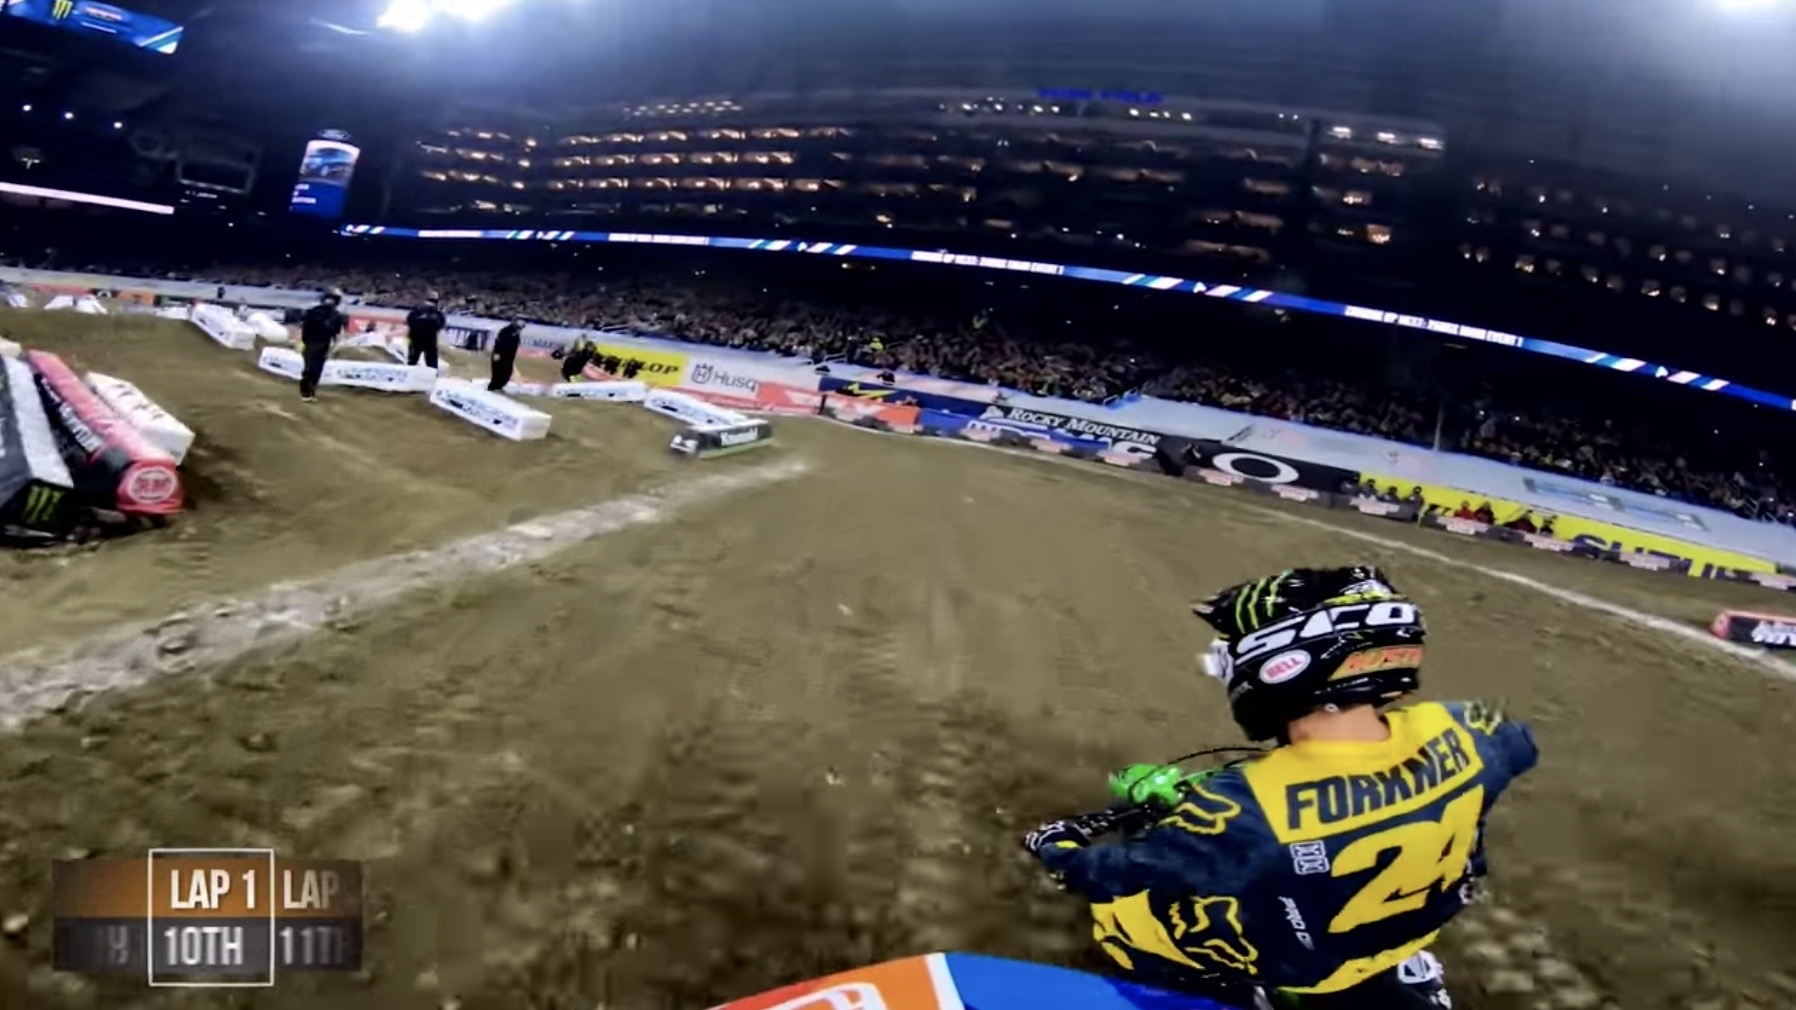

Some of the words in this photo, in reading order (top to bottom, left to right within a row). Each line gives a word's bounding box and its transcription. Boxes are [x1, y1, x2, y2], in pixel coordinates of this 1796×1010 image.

[713, 370, 757, 393] Husq
[1007, 407, 1061, 427] ROCKY
[1065, 418, 1161, 446] MOUNTAIN
[1265, 657, 1302, 679] BELL
[1285, 727, 1471, 831] FORKNER
[1328, 784, 1485, 934] 24
